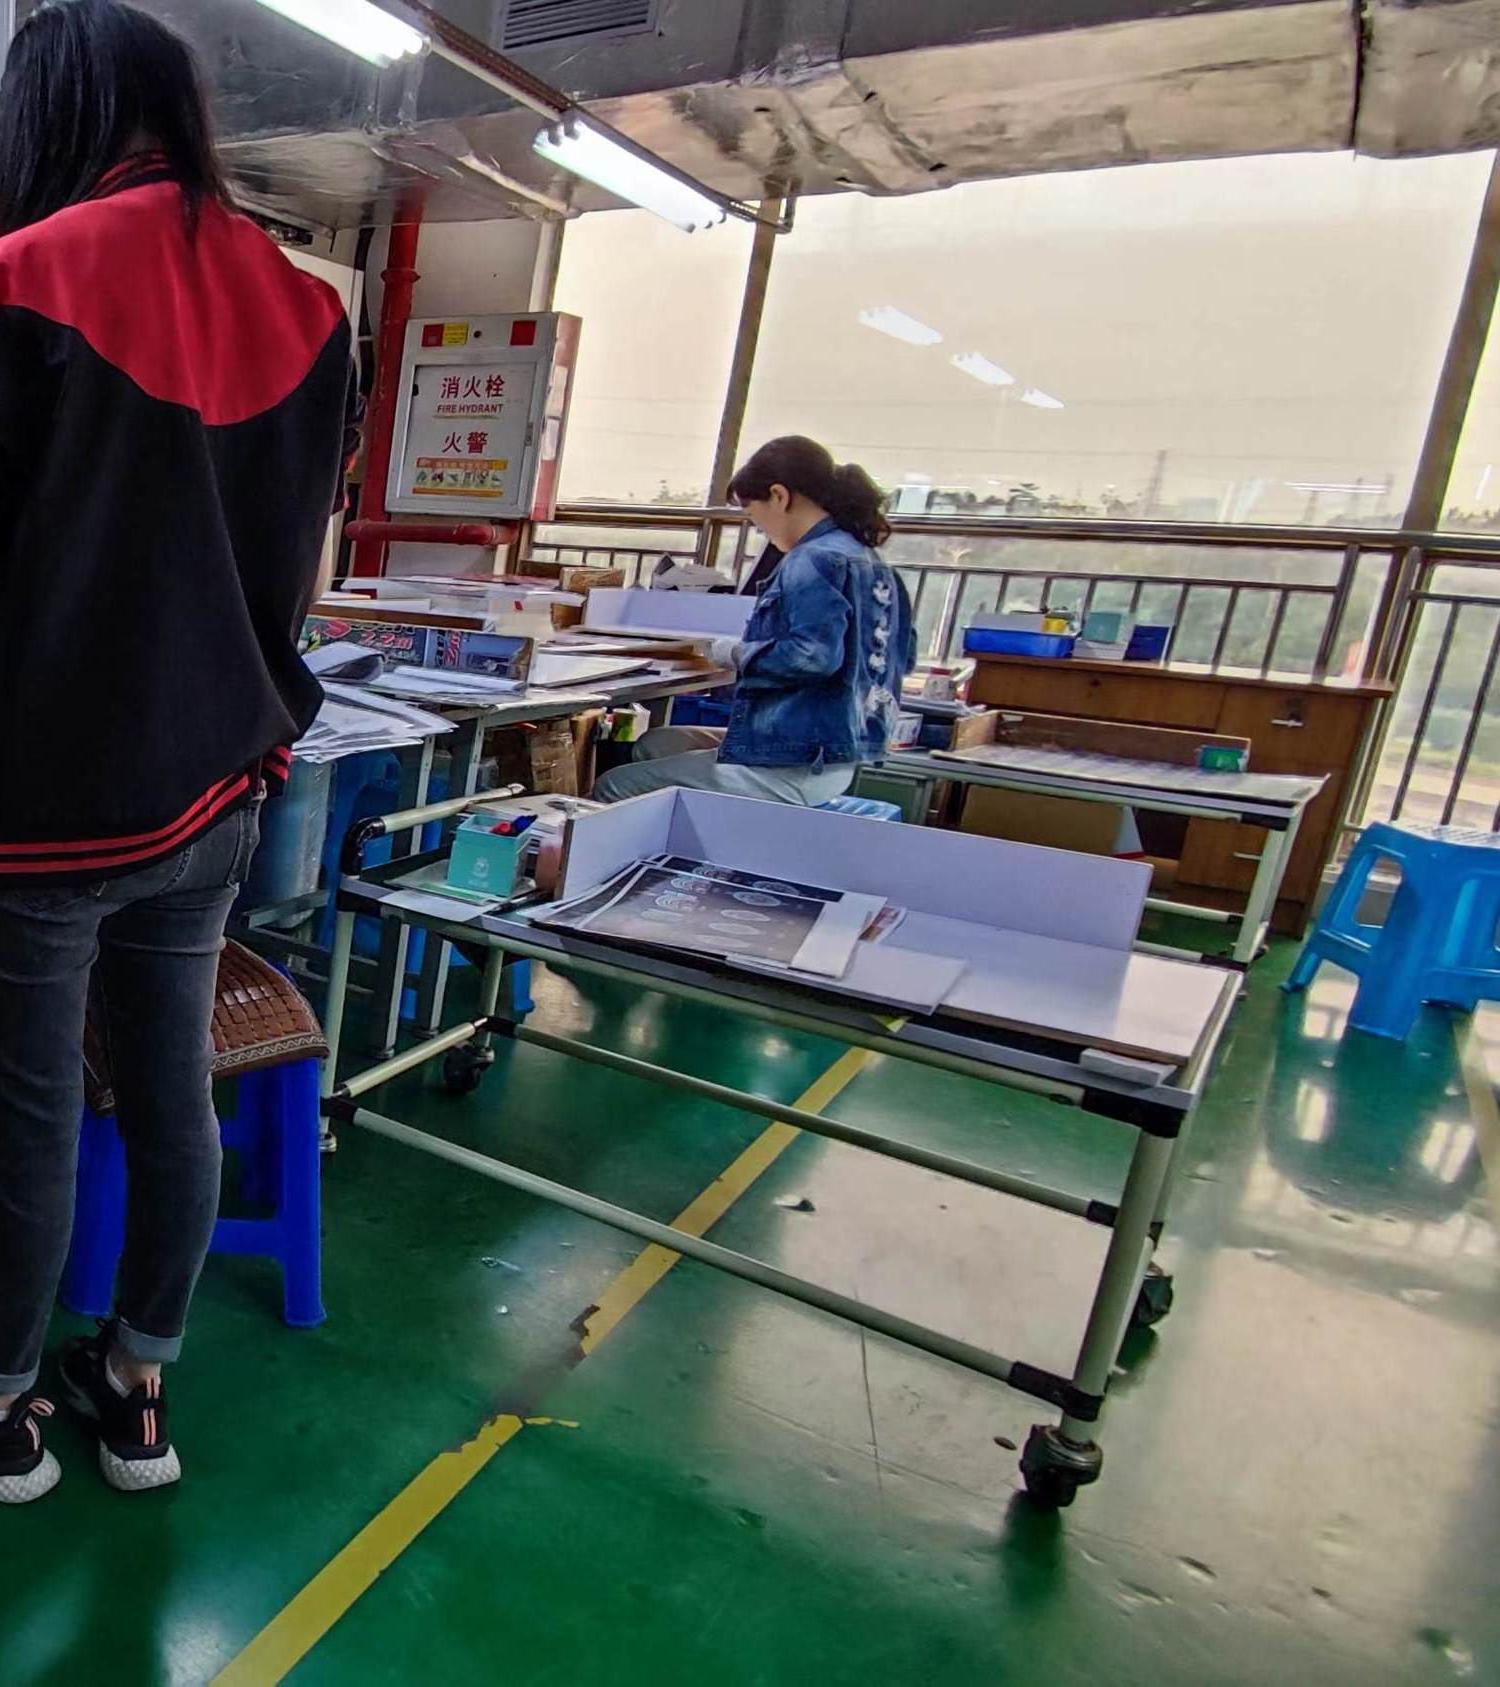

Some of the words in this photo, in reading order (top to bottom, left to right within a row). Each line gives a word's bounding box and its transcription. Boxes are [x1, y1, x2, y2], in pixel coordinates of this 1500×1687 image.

[440, 374, 505, 399] 消火栓
[437, 404, 457, 413] FIRE
[459, 403, 504, 413] HYDRANT
[442, 431, 488, 454] 火警
